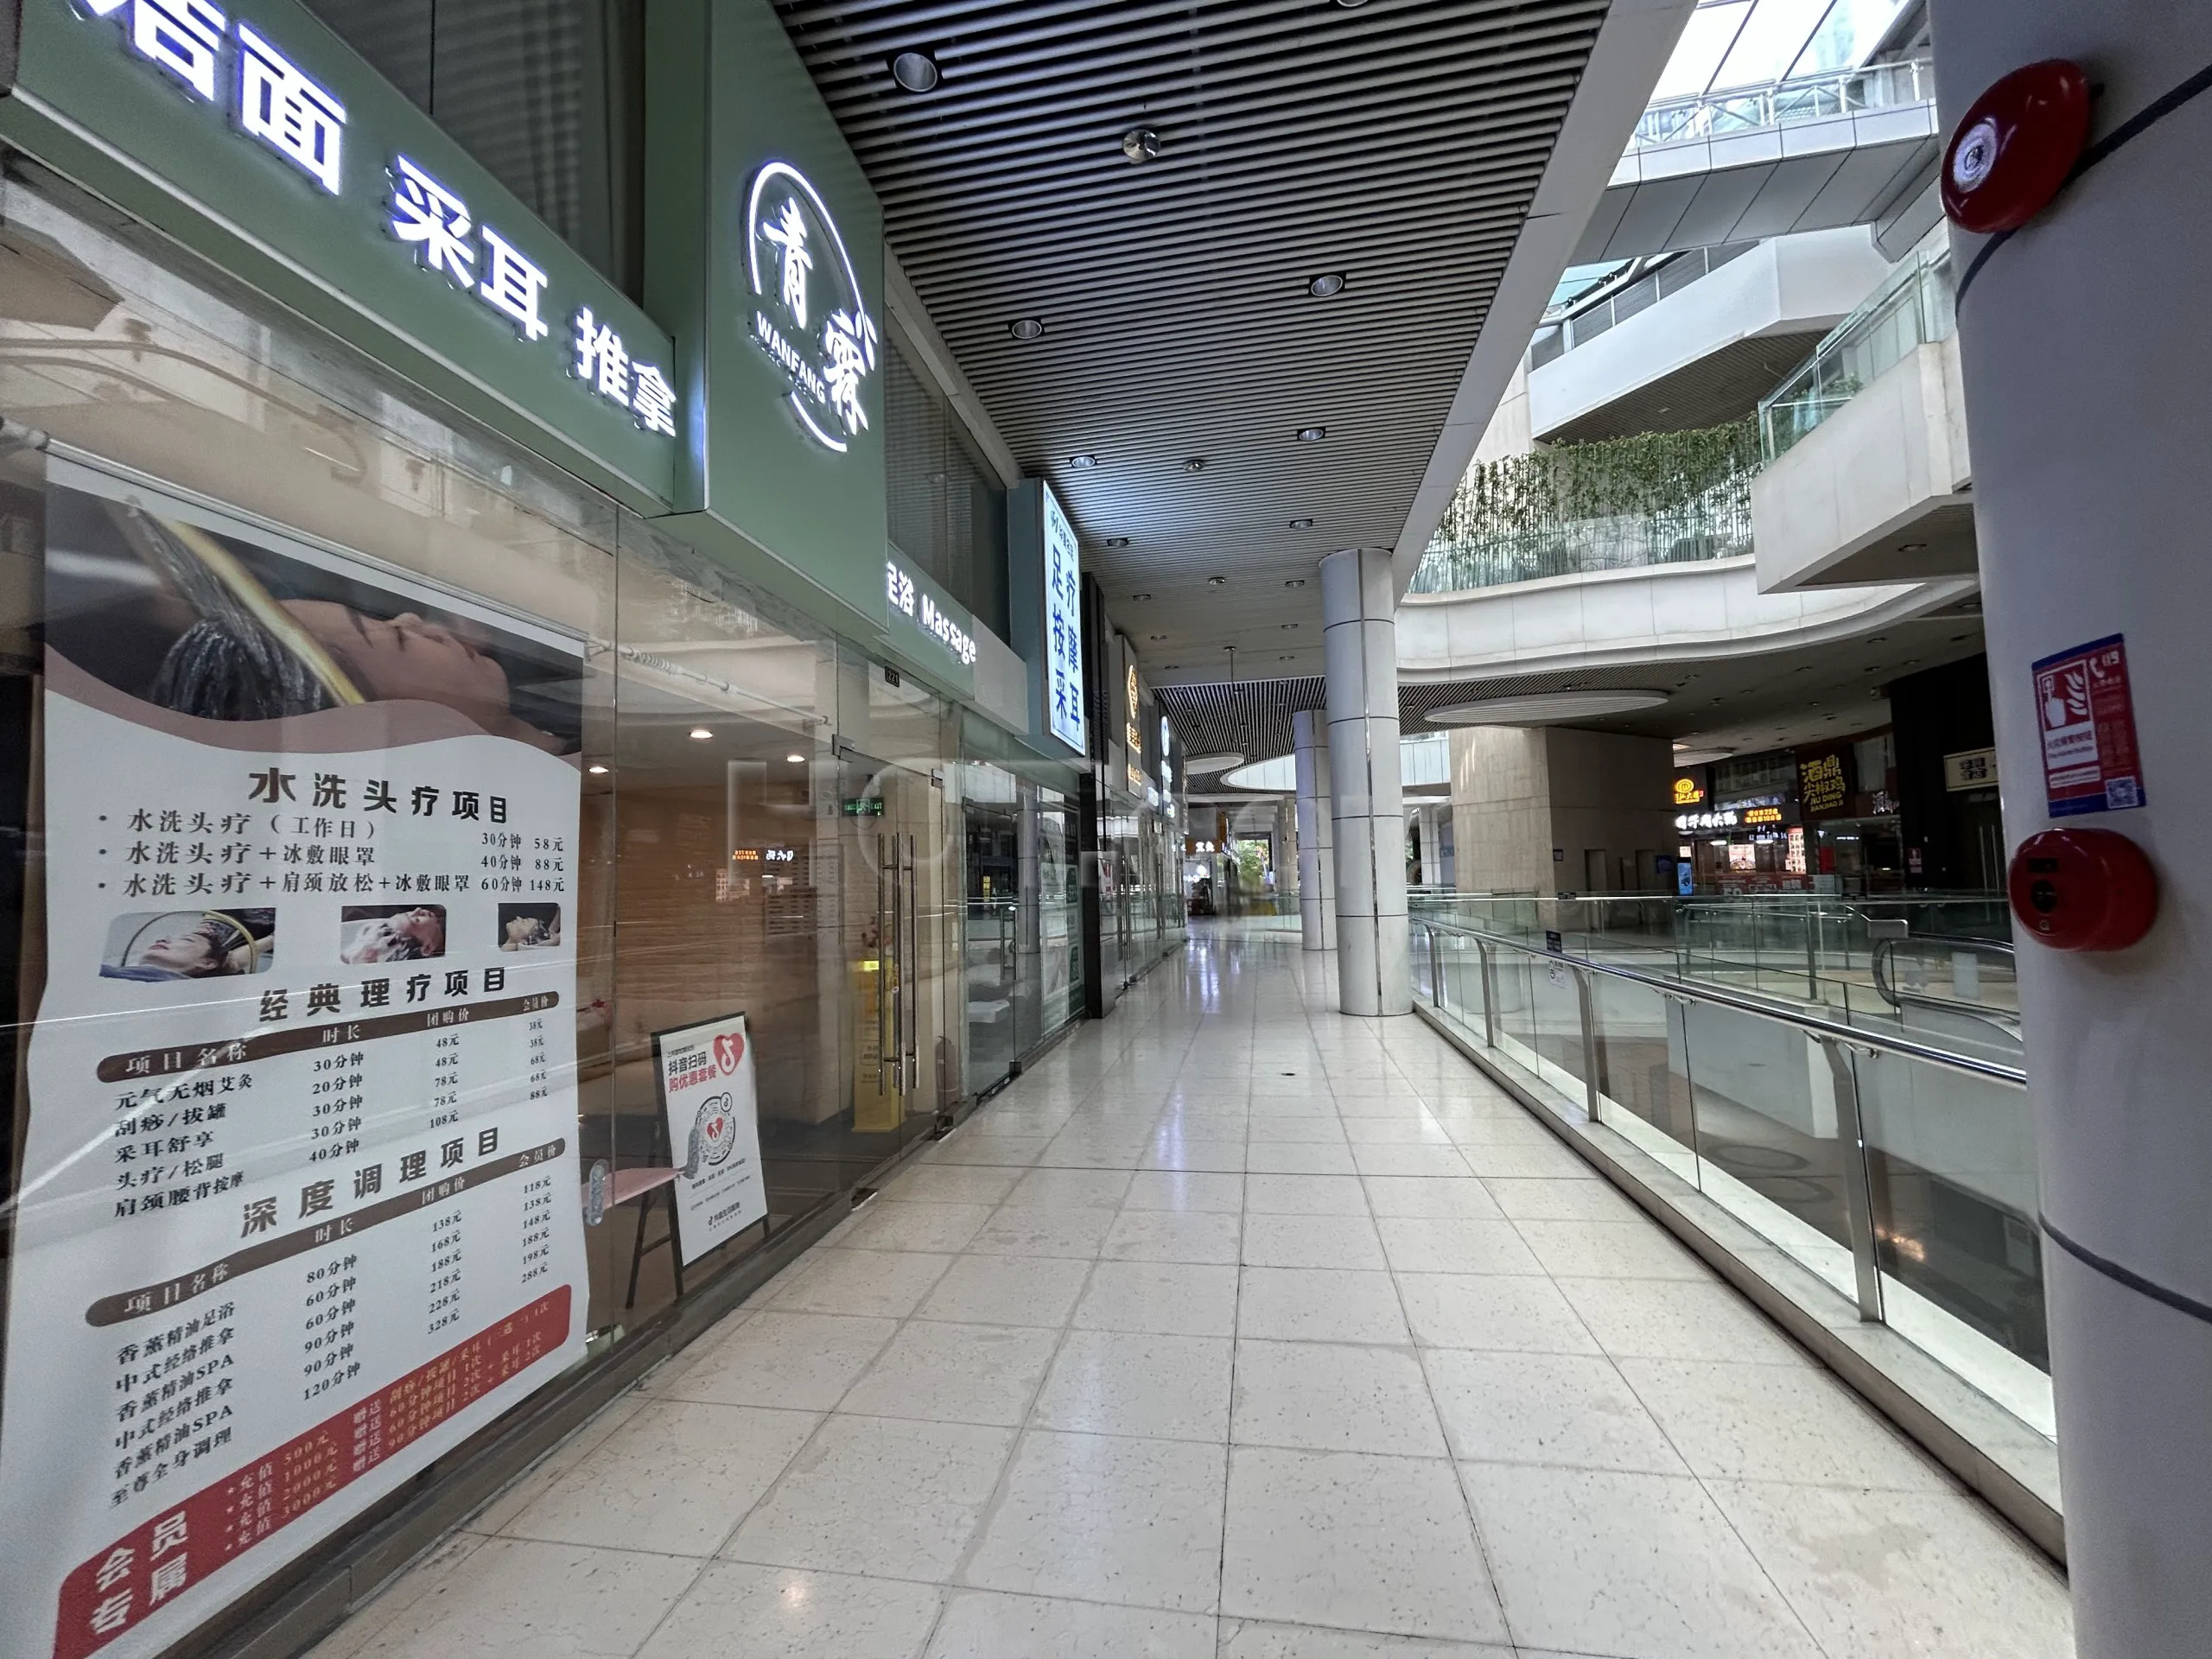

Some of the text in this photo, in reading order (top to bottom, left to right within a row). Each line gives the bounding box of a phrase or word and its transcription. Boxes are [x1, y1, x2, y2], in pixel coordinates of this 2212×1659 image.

[393, 154, 549, 341] 采耳
[575, 308, 677, 436] 推拿
[756, 310, 826, 404] WANFANG
[1052, 543, 1077, 617] 足疗
[922, 593, 976, 665] Massage
[1053, 603, 1078, 674] 按摩
[1055, 668, 1081, 731] 采耳
[249, 767, 508, 823] 水洗头疗项目
[126, 840, 564, 873] 水洗头疗+冰敷眼罩 40分钟 88元
[481, 832, 522, 850] 30分钟
[535, 836, 564, 853] 58元
[480, 875, 523, 894] 60分钟
[529, 878, 565, 894] 148元
[259, 966, 506, 1023] 经典理疗项目
[126, 1043, 247, 1077] 项目名称
[321, 1023, 361, 1044] 时长
[426, 1009, 469, 1027] 团购价
[313, 1051, 365, 1074] 30分钟
[435, 1033, 460, 1049] 48元
[668, 1051, 707, 1077] 抖音扫码
[669, 1064, 717, 1094] 购优惠套餐
[114, 1130, 214, 1164] 采耳舒享
[312, 1094, 364, 1118] 30分钟
[434, 1071, 459, 1089] 78元
[115, 1102, 227, 1139] 刮痧/拔罐
[312, 1073, 364, 1096] 20分钟
[435, 1052, 460, 1069] 48元
[311, 1115, 363, 1141] 30分钟
[434, 1090, 458, 1108] 78元
[114, 1171, 245, 1219] 肩颈腰背按摩
[308, 1137, 360, 1164] 40分钟
[429, 1110, 460, 1130] 108元
[240, 1128, 500, 1239] 深度调理项目
[124, 1141, 557, 1316] 项目名称 时长 团购价 会员价
[305, 1275, 357, 1308] 60分钟
[430, 1229, 462, 1253] 168元
[523, 1192, 553, 1214] 138元
[306, 1252, 358, 1286] 80分钟
[431, 1210, 463, 1232] 138元
[523, 1174, 553, 1195] 118元
[302, 1343, 354, 1378] 90分钟
[428, 1289, 461, 1315] 228元
[521, 1244, 550, 1266] 198元
[303, 1320, 355, 1355] 90分钟
[429, 1269, 461, 1294] 218元
[521, 1227, 551, 1249] 188元
[304, 1298, 356, 1332] 60分钟
[430, 1249, 462, 1274] 188元
[522, 1209, 552, 1231] 148元
[302, 1361, 361, 1402] 120分钟
[427, 1308, 461, 1336] 328元
[520, 1261, 550, 1285] 288元
[95, 1510, 189, 1592] 会员
[89, 1554, 188, 1637] 专属
